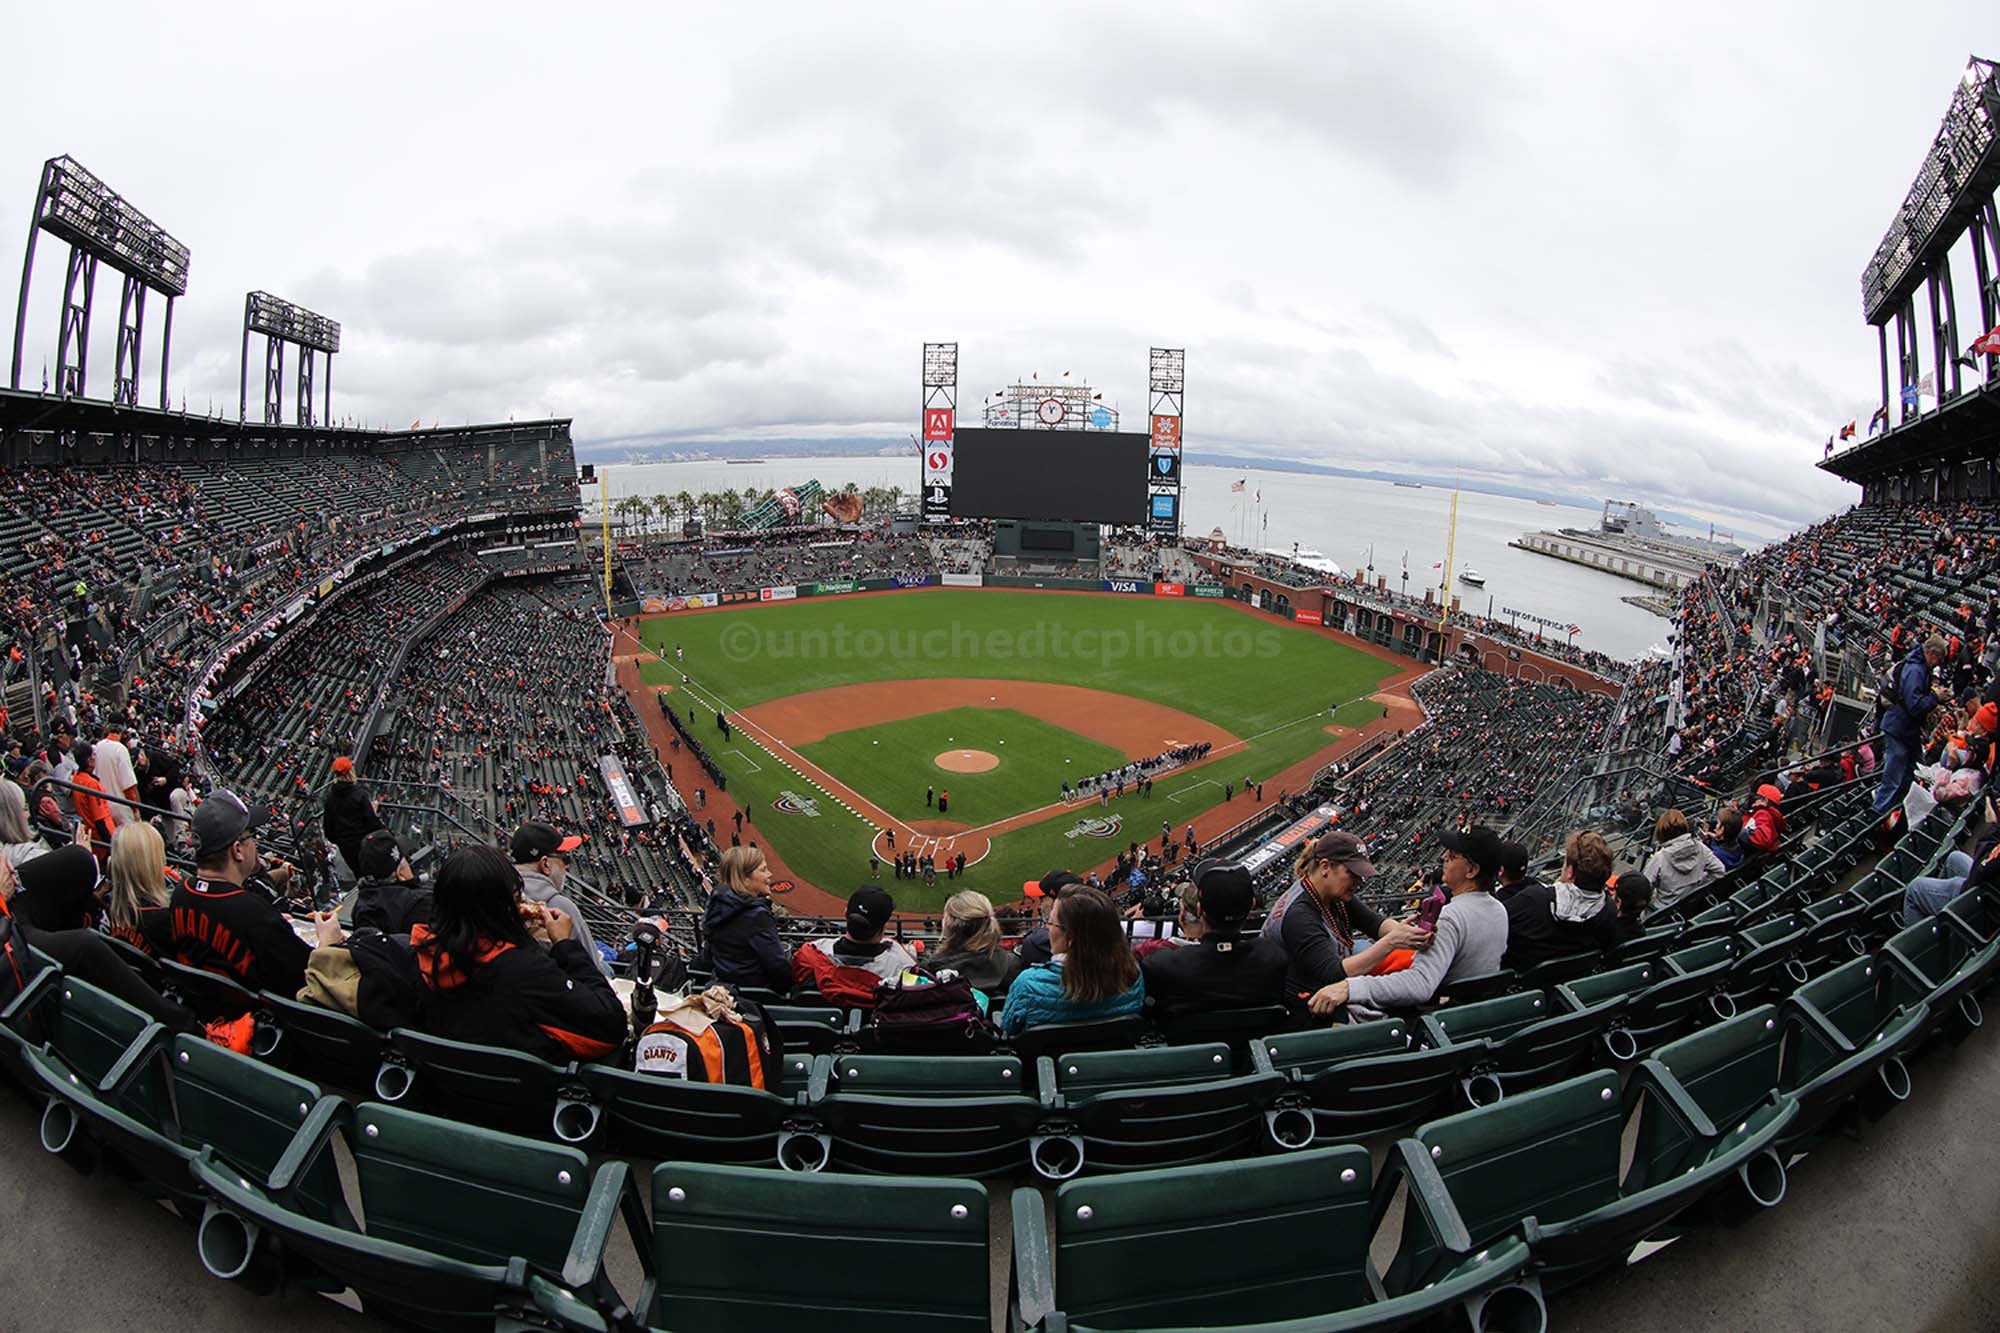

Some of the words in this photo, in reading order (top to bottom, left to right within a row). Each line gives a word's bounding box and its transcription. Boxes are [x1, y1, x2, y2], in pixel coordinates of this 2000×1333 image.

[503, 569, 527, 577] WELCOME
[1111, 581, 1137, 592] VISA
[1356, 598, 1393, 616] LANDING
[1503, 607, 1521, 618] BANK
[1531, 615, 1564, 629] AMERICA
[643, 1048, 678, 1062] GIANTS
